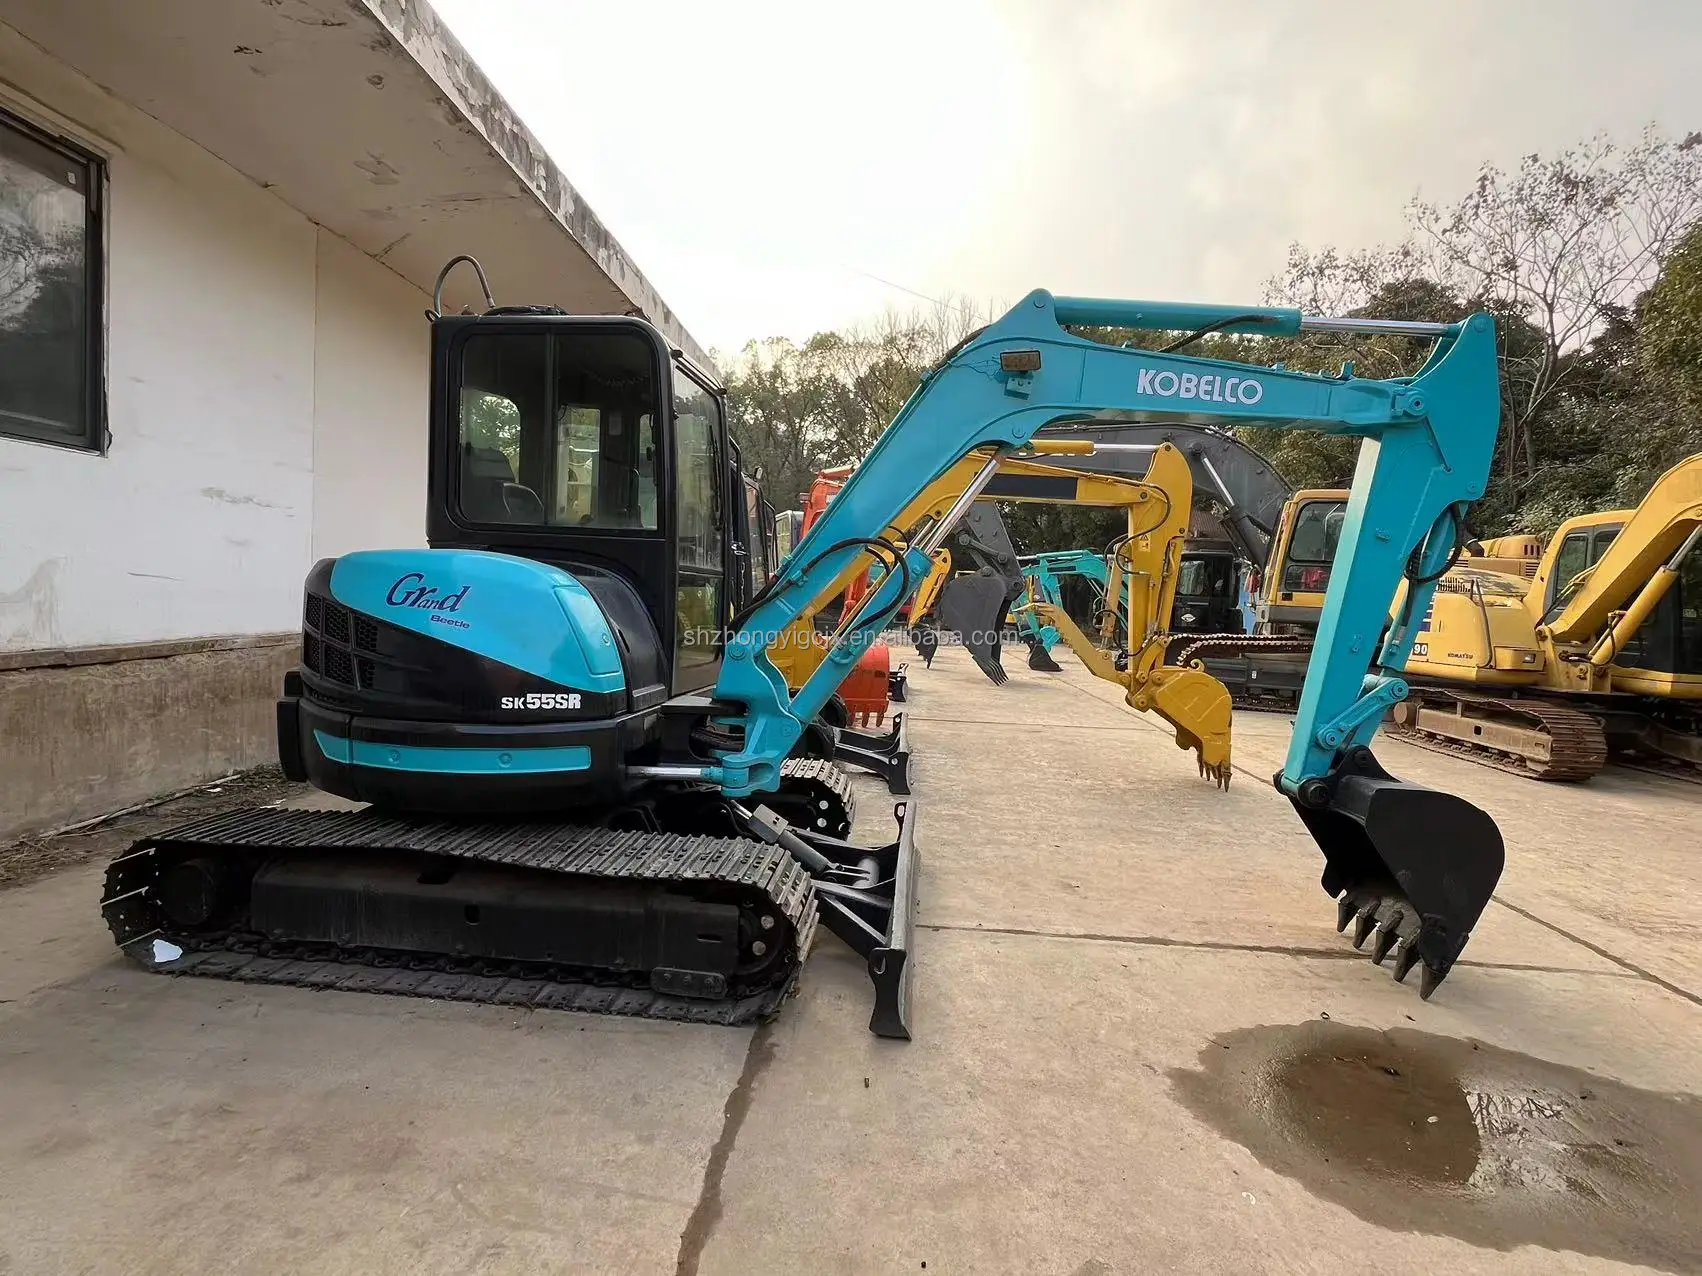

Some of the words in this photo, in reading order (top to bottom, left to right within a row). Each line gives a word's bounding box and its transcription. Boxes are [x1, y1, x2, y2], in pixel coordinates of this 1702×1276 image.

[1137, 368, 1263, 405] KOBELCO
[385, 572, 471, 612] Grand
[430, 614, 470, 629] Beetle
[501, 693, 582, 709] SK55SR
